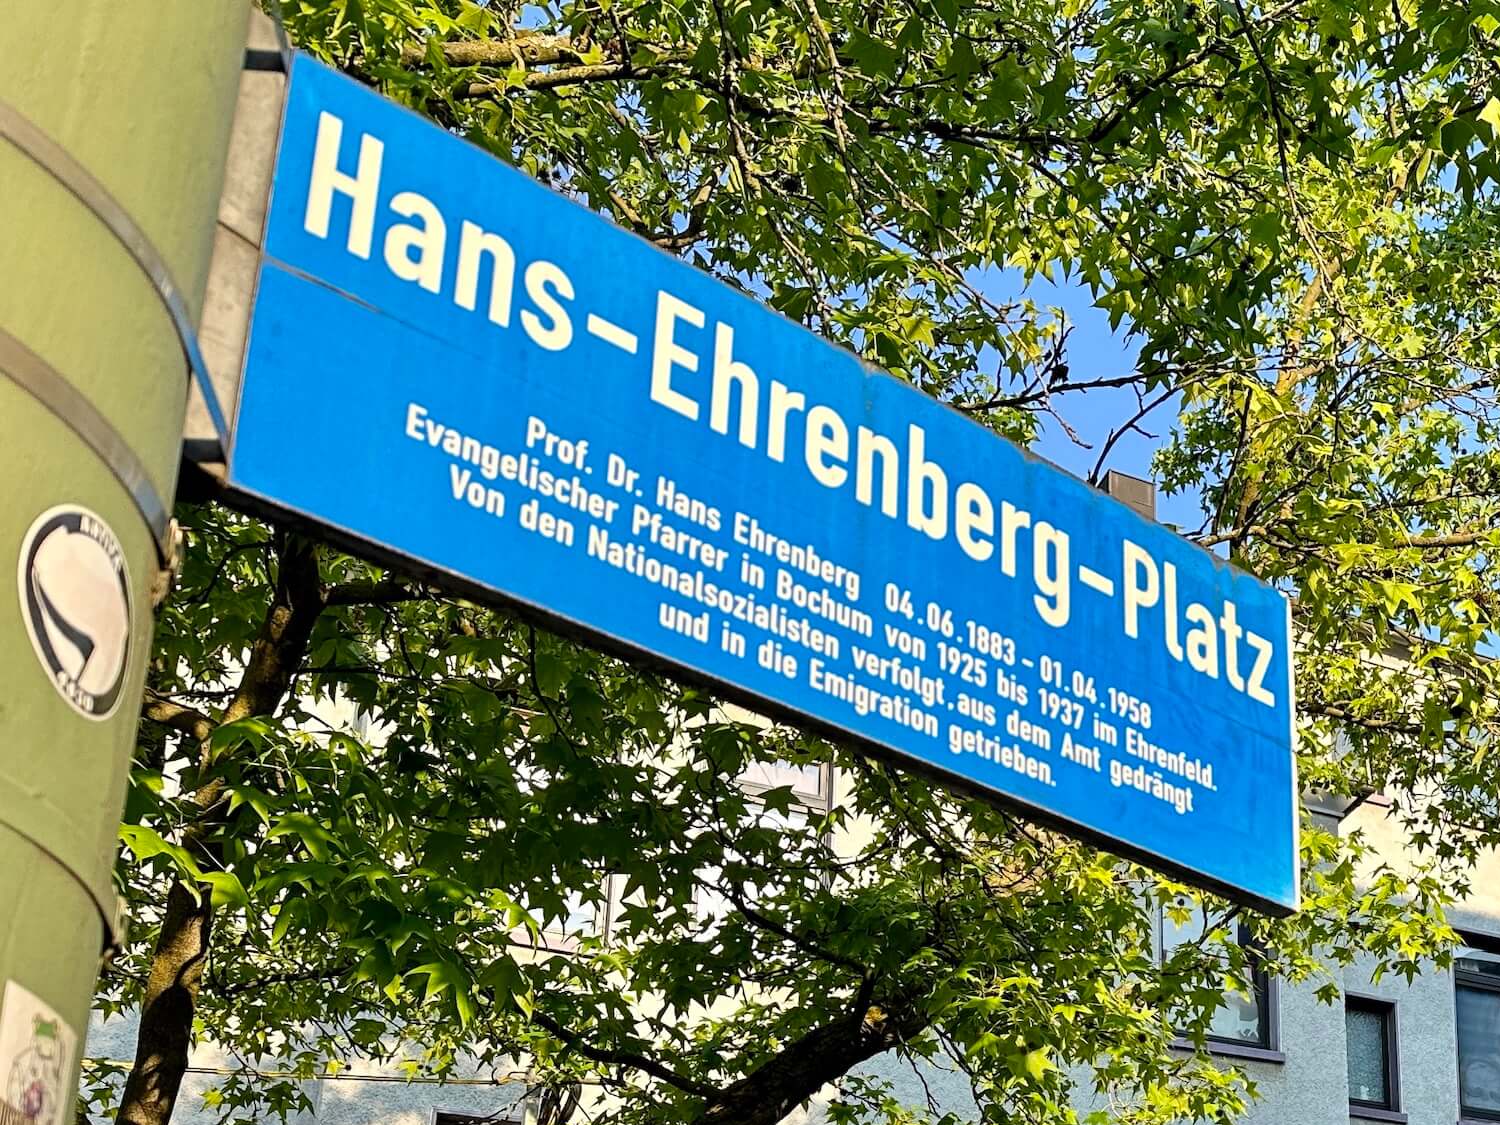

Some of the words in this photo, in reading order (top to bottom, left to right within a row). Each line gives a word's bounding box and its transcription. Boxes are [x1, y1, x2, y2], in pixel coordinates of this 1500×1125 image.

[304, 111, 1275, 707] Hans-Ehrenberg-Platz
[526, 416, 592, 474] Prof.
[607, 453, 643, 497] Dr.
[656, 476, 721, 531] Hans
[733, 511, 860, 602] Ehrenberg
[405, 403, 619, 523] Evangelischer
[631, 504, 729, 572] Pfarrer
[740, 552, 765, 590] in
[775, 568, 873, 638] Bochum
[884, 624, 926, 661] von
[937, 641, 987, 688] 1925
[997, 668, 1028, 706] bis
[1038, 687, 1085, 730] 1937
[1093, 712, 1118, 747] im
[1125, 727, 1217, 791] Ehrenfeld.
[450, 463, 505, 517] Von
[519, 499, 574, 546] den
[587, 524, 840, 660] Nationalsozialisten
[1006, 709, 1051, 750] dem
[1060, 732, 1101, 772] Amt
[1110, 759, 1194, 815] gedrängt
[659, 603, 710, 643] und
[721, 621, 746, 658] in
[758, 639, 798, 679] die
[809, 658, 939, 738] Emigration
[949, 724, 1057, 787] getrieben.
